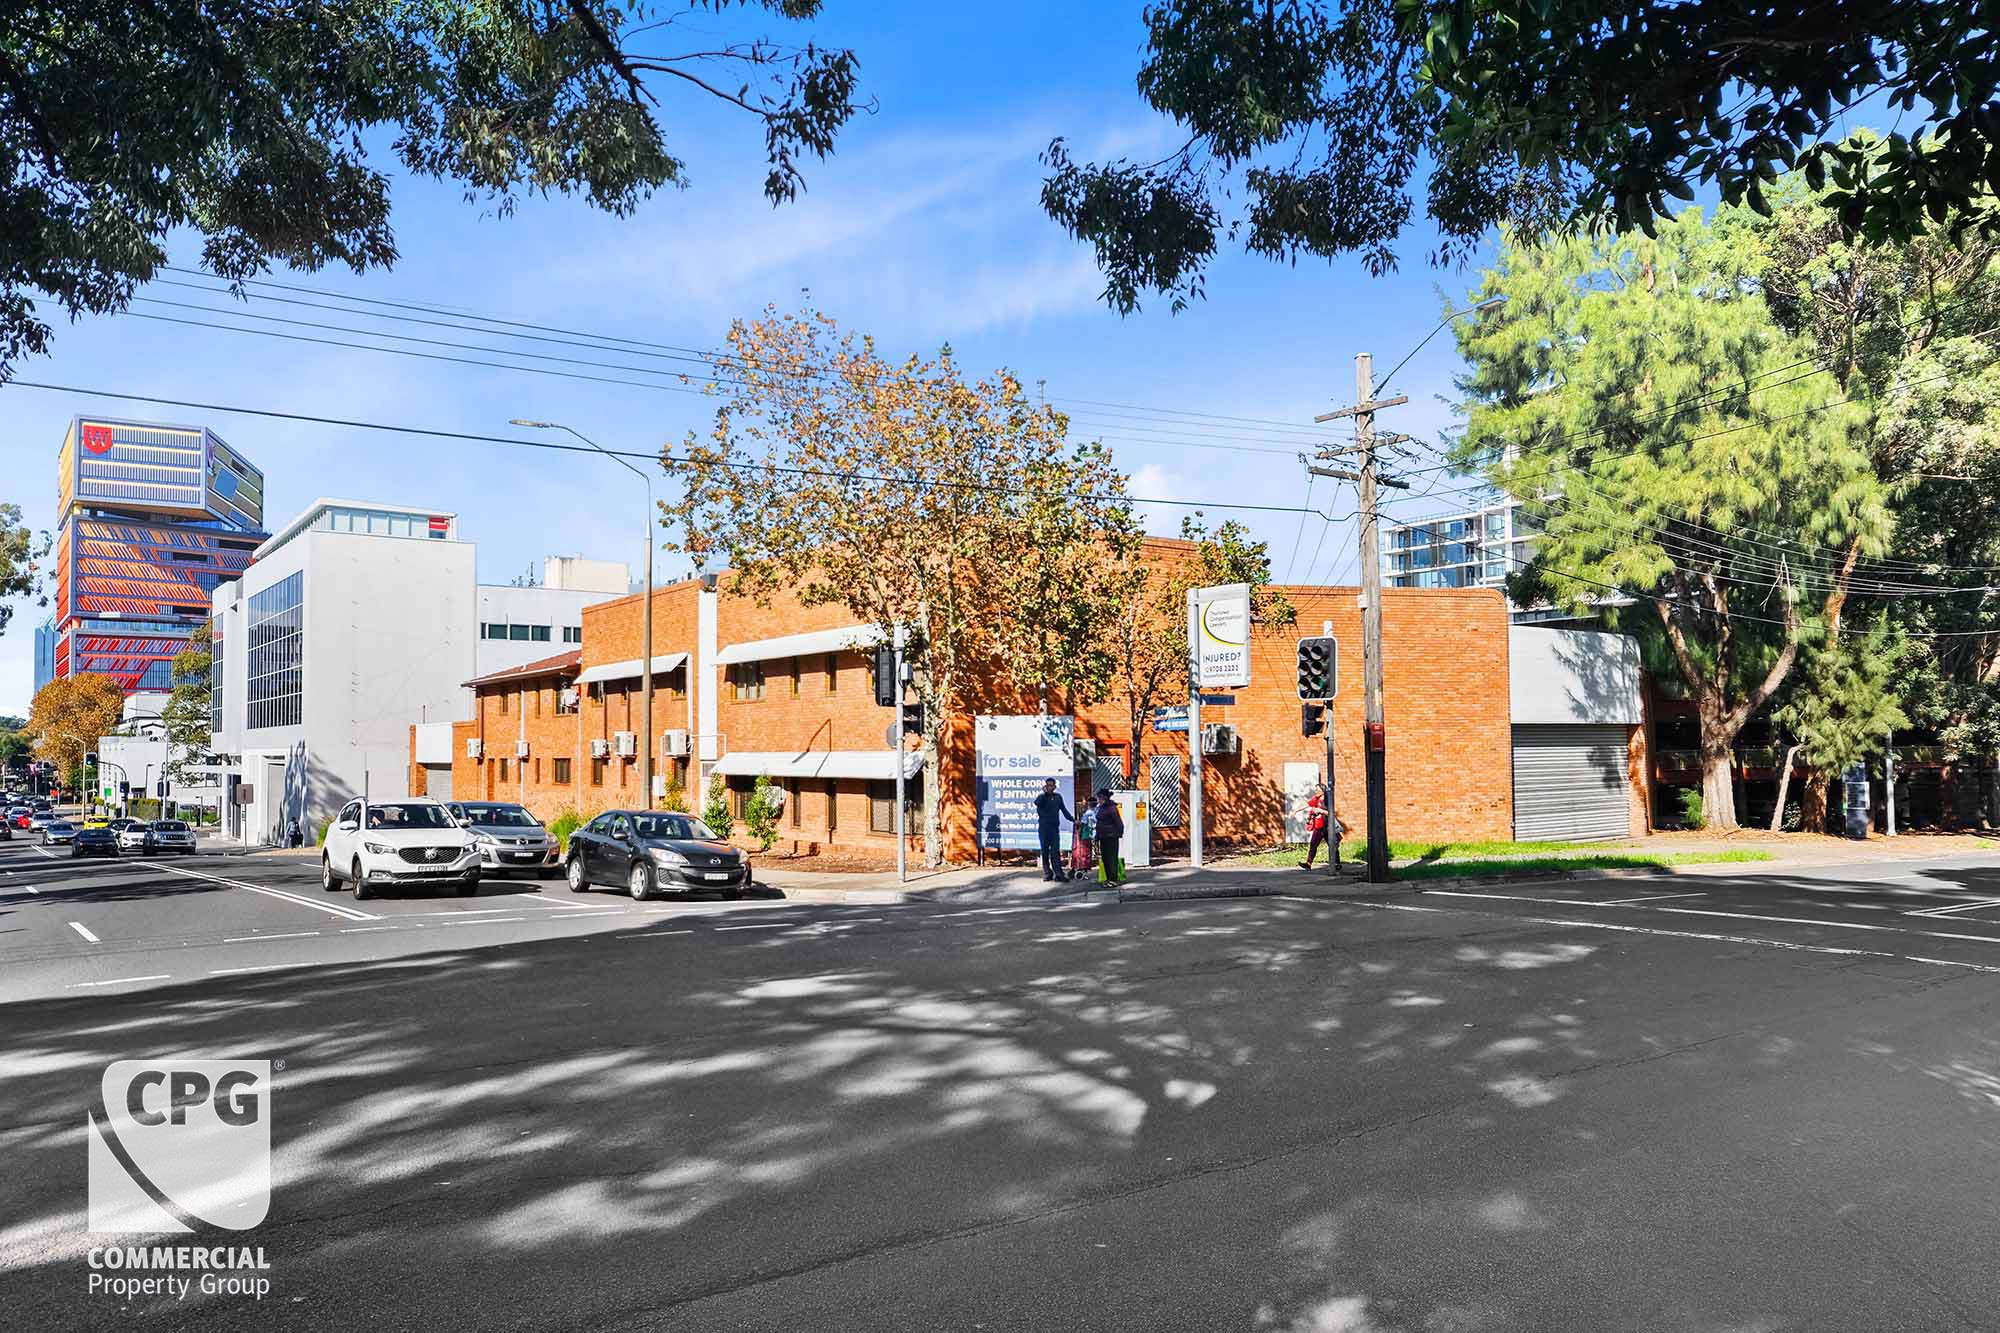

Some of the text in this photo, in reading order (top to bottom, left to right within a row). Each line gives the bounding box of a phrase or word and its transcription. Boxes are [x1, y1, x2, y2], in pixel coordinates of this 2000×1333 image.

[1203, 652, 1241, 663] INJURED?
[983, 754, 1041, 768] for sale
[991, 780, 1021, 788] WHOLE
[995, 790, 1001, 798] 3
